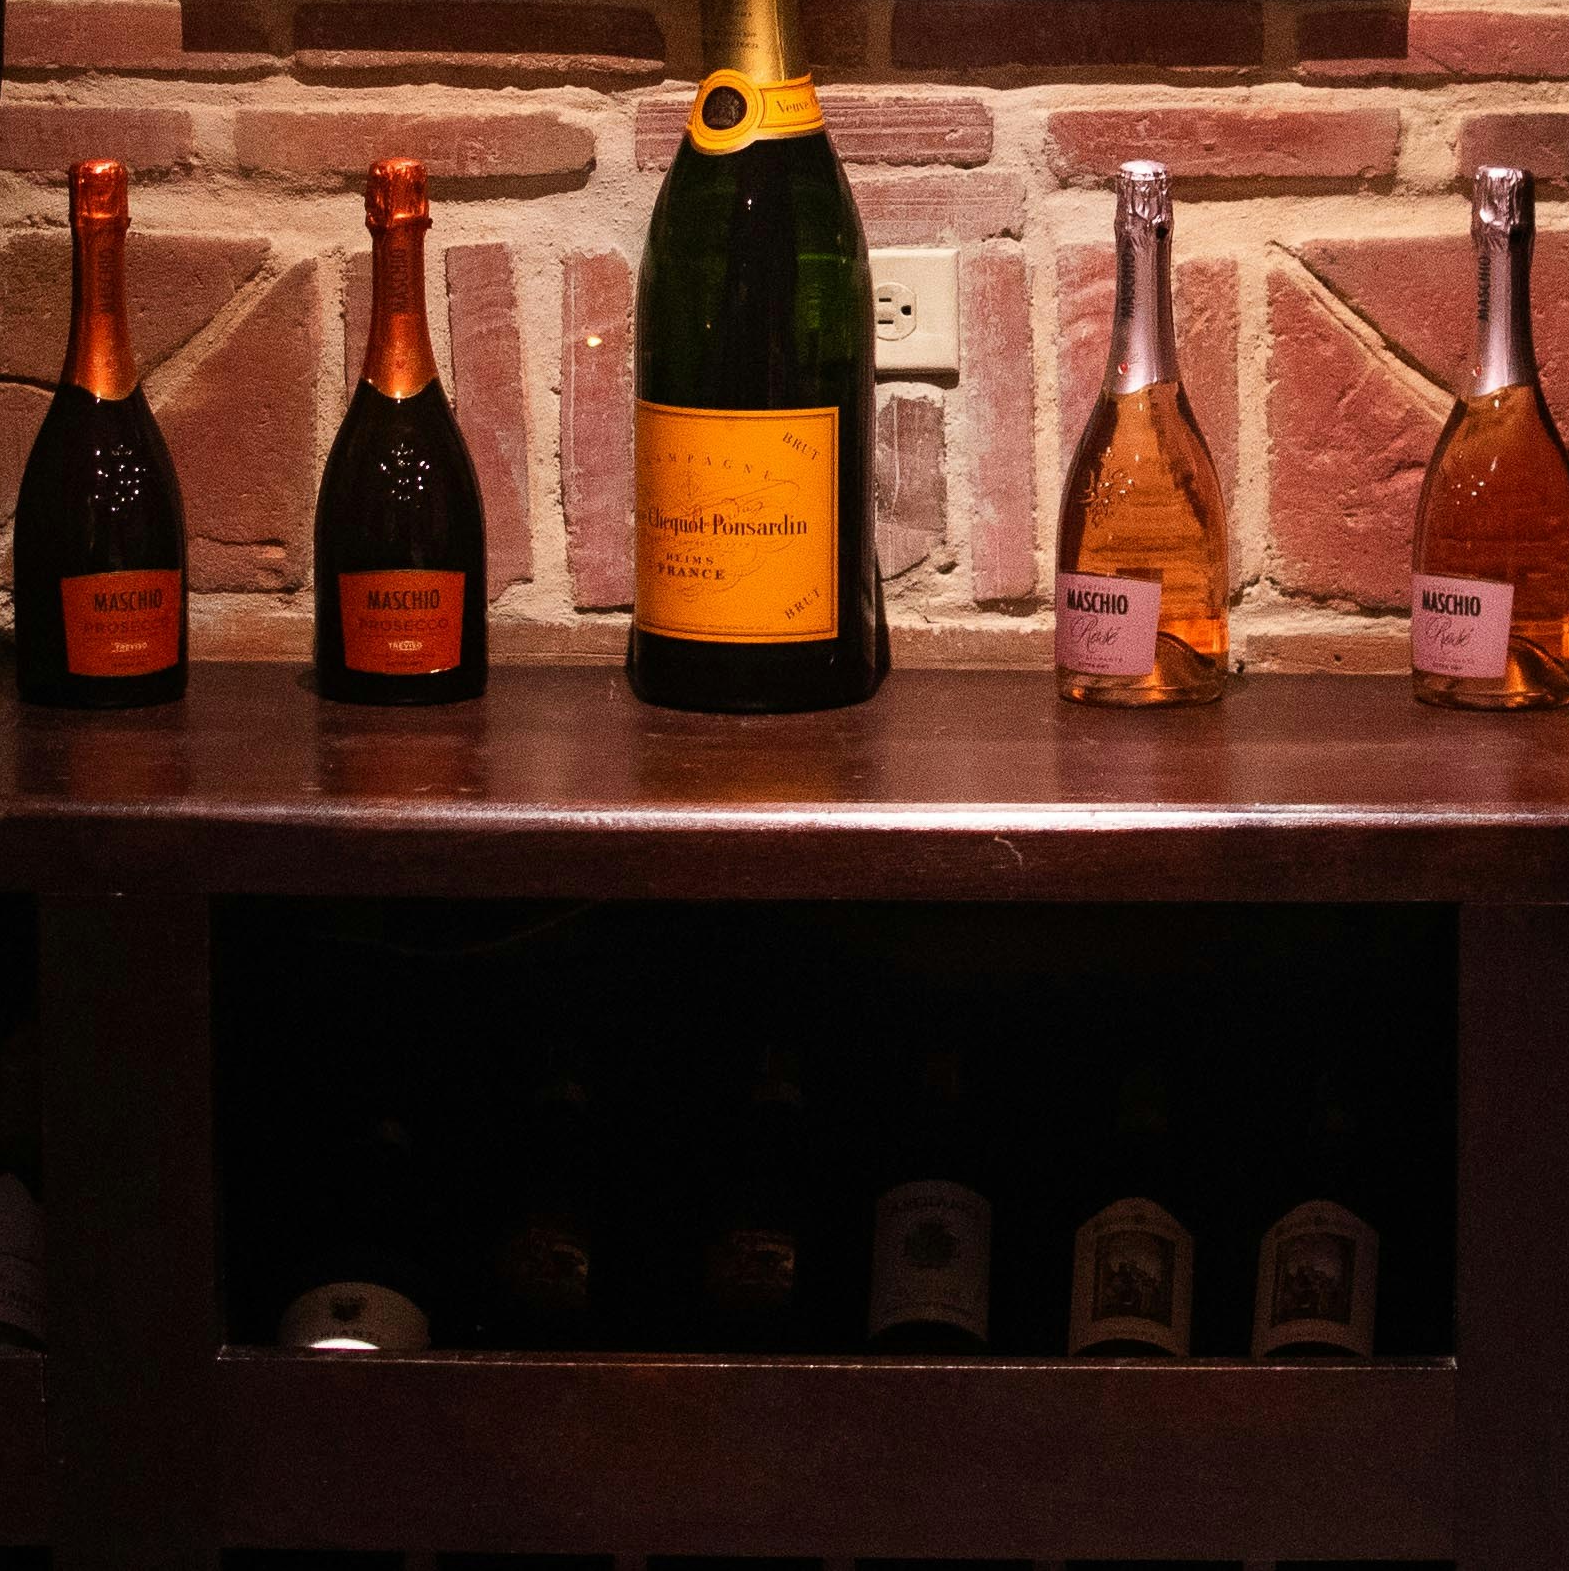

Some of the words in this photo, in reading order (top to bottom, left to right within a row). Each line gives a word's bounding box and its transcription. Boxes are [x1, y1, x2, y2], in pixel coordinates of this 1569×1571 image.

[776, 100, 810, 113] Veuve
[1477, 255, 1491, 321] MASCHIO
[782, 432, 820, 461] BRUT
[712, 513, 808, 536] Ponsardin
[665, 552, 714, 566] REIMS
[657, 562, 726, 580] FRANCE
[94, 589, 163, 612] MASCHIO
[368, 589, 441, 611] MASCHIO
[784, 589, 821, 620] BRUT
[1066, 588, 1129, 615] MASCHIO
[1422, 589, 1481, 617] MASCHIO
[358, 617, 449, 632] PROSECCO
